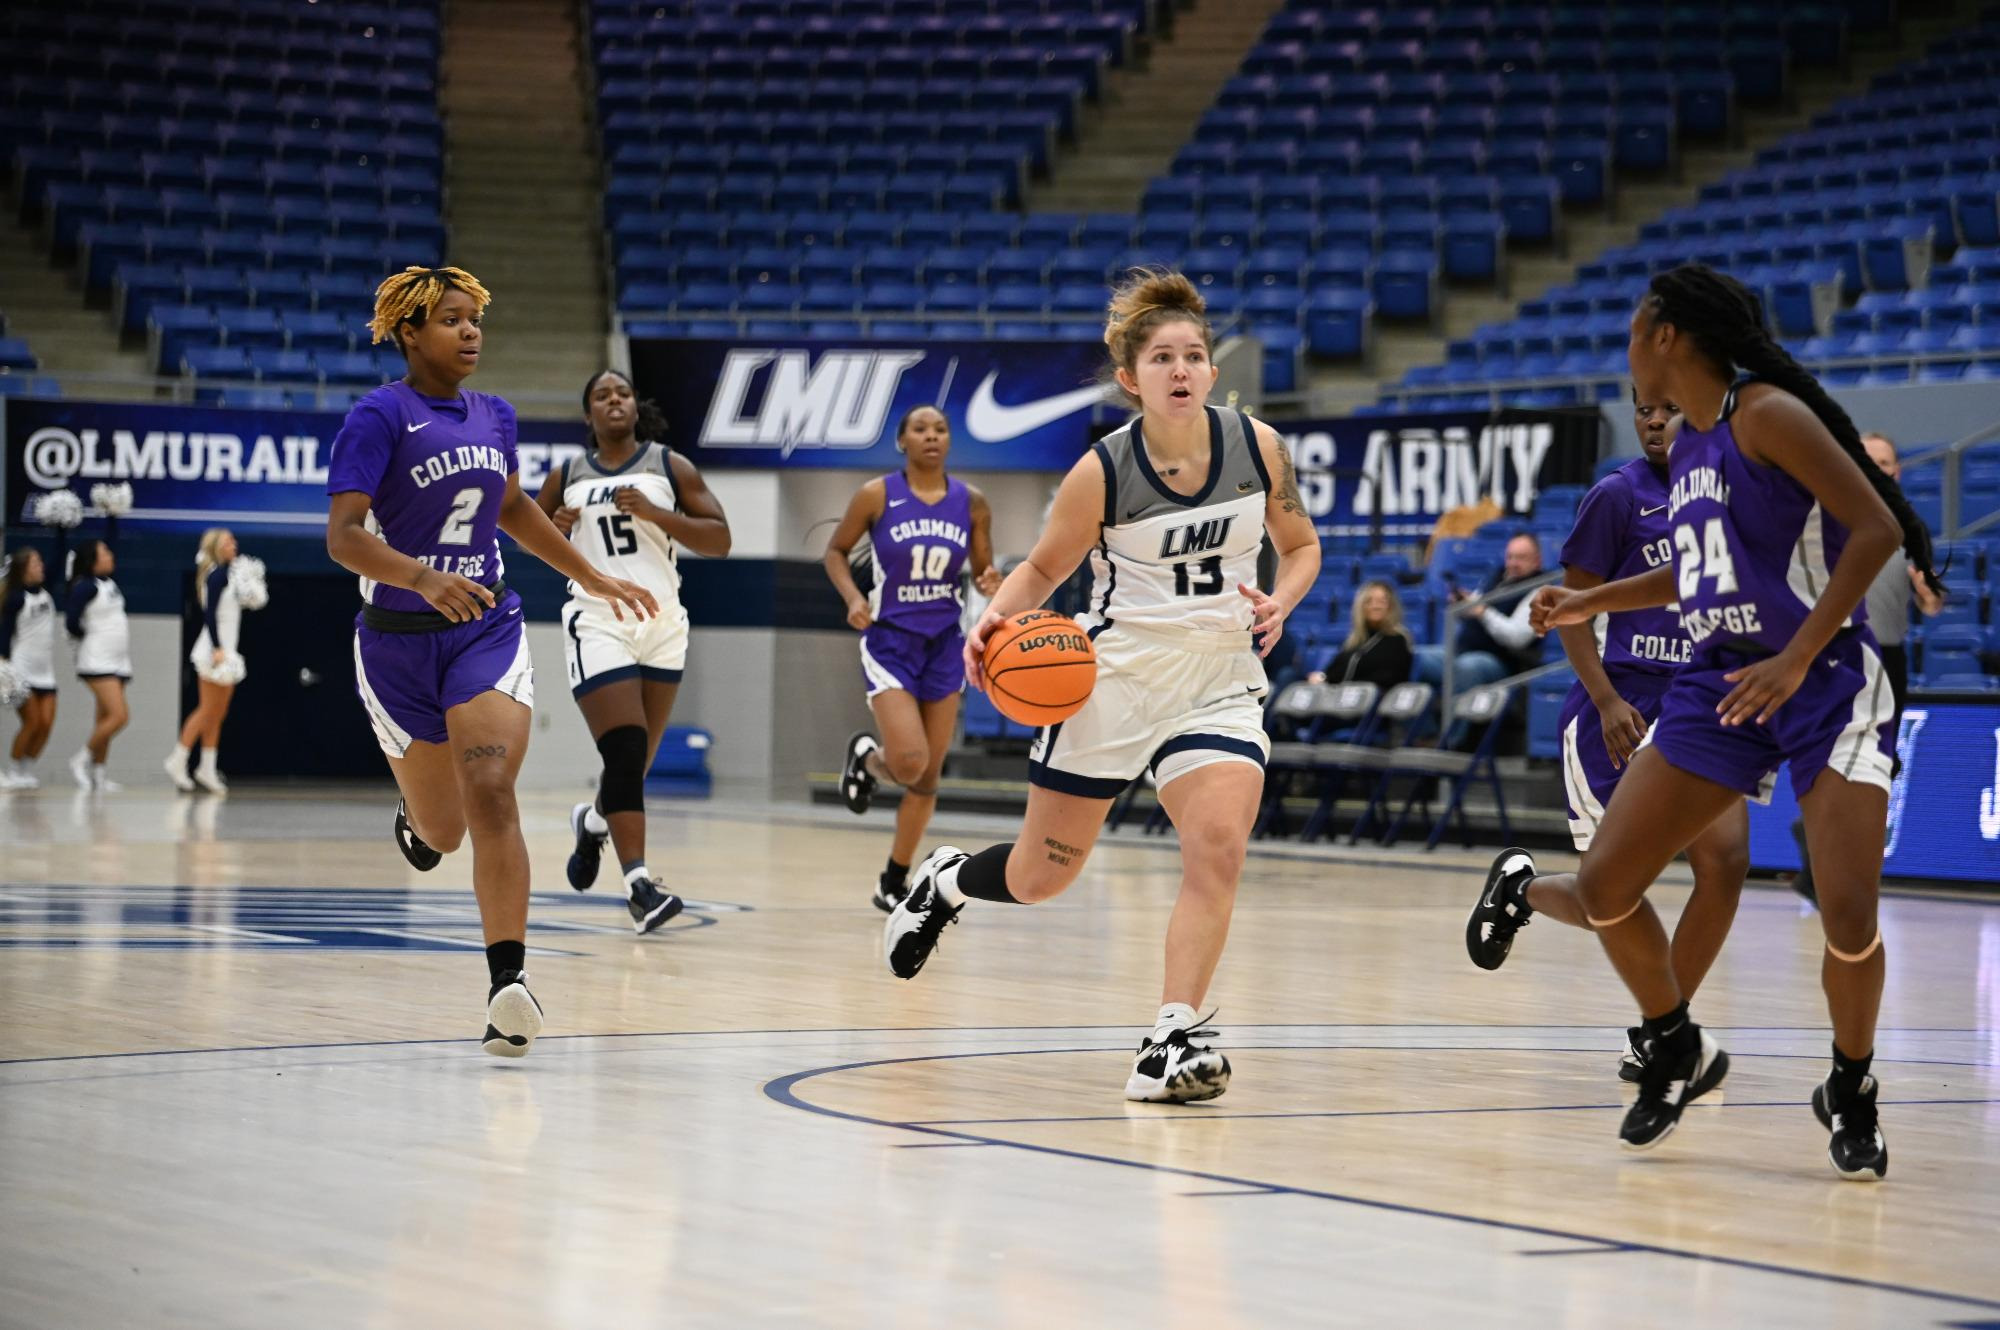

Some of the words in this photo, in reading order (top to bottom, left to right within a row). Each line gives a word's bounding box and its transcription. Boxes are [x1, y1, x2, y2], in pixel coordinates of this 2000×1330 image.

[698, 348, 926, 460] LMU
[24, 427, 330, 489] @LMURAIL
[1352, 423, 1554, 516] ARMY
[1668, 466, 1730, 522] OLUMB
[438, 487, 484, 546] 2
[597, 514, 638, 557] 15
[889, 518, 967, 548] COLUMBIA
[1158, 513, 1239, 560] LMU
[416, 553, 486, 578] OLLEGE
[910, 544, 952, 580] 10
[1172, 555, 1224, 596] 13
[1674, 517, 1740, 601] 24
[1018, 633, 1090, 654] Wilson
[1631, 634, 1695, 663] COLLE
[463, 745, 507, 762] 2002
